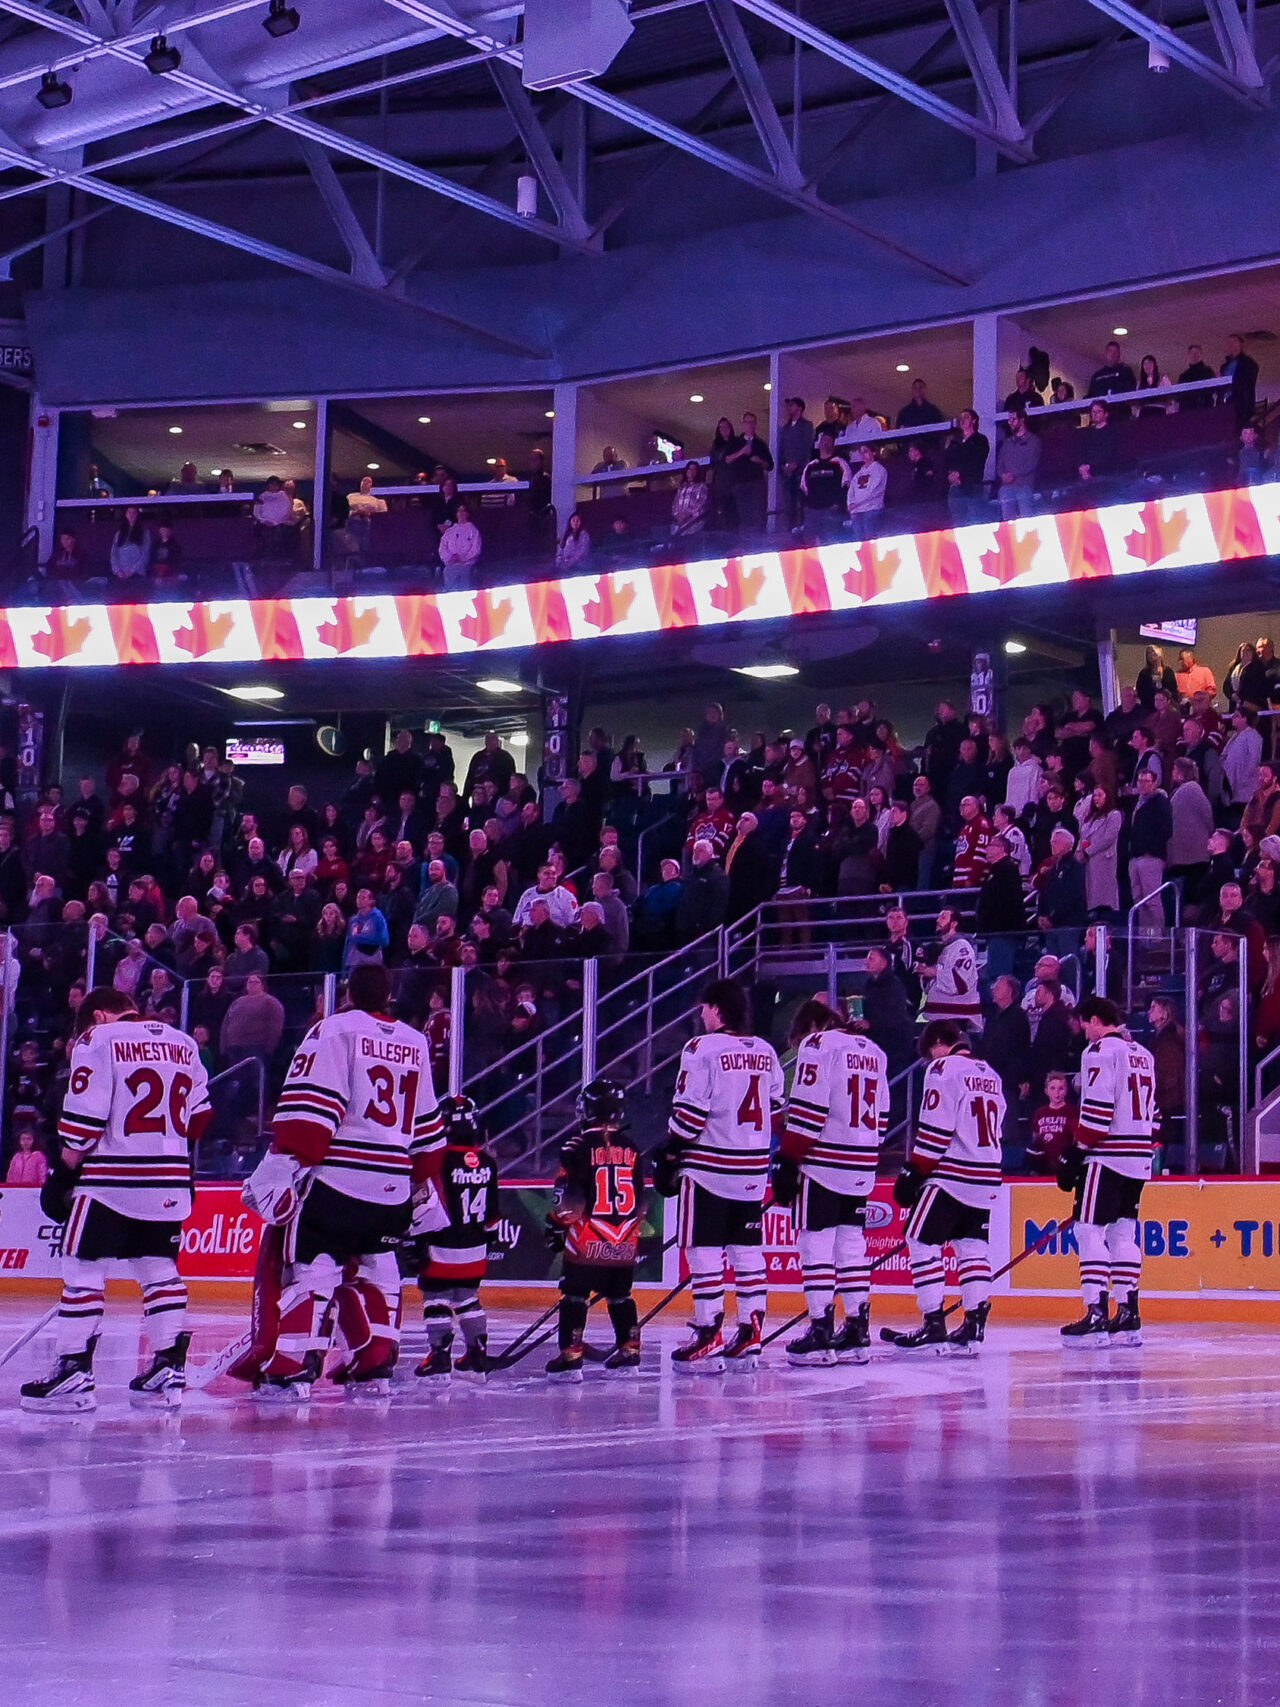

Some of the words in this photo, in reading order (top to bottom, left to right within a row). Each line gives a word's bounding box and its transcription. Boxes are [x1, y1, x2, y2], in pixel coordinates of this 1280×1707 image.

[288, 1051, 316, 1078] 31
[720, 1053, 772, 1072] BUCHINGE
[797, 1062, 819, 1087] 15
[123, 1067, 193, 1138] 26
[363, 1064, 419, 1135] 31
[737, 1074, 763, 1132] 4
[846, 1073, 878, 1131] 15
[922, 1088, 941, 1112] 10
[1128, 1072, 1153, 1121] 17
[461, 1187, 488, 1224] 14
[591, 1166, 636, 1215] 15
